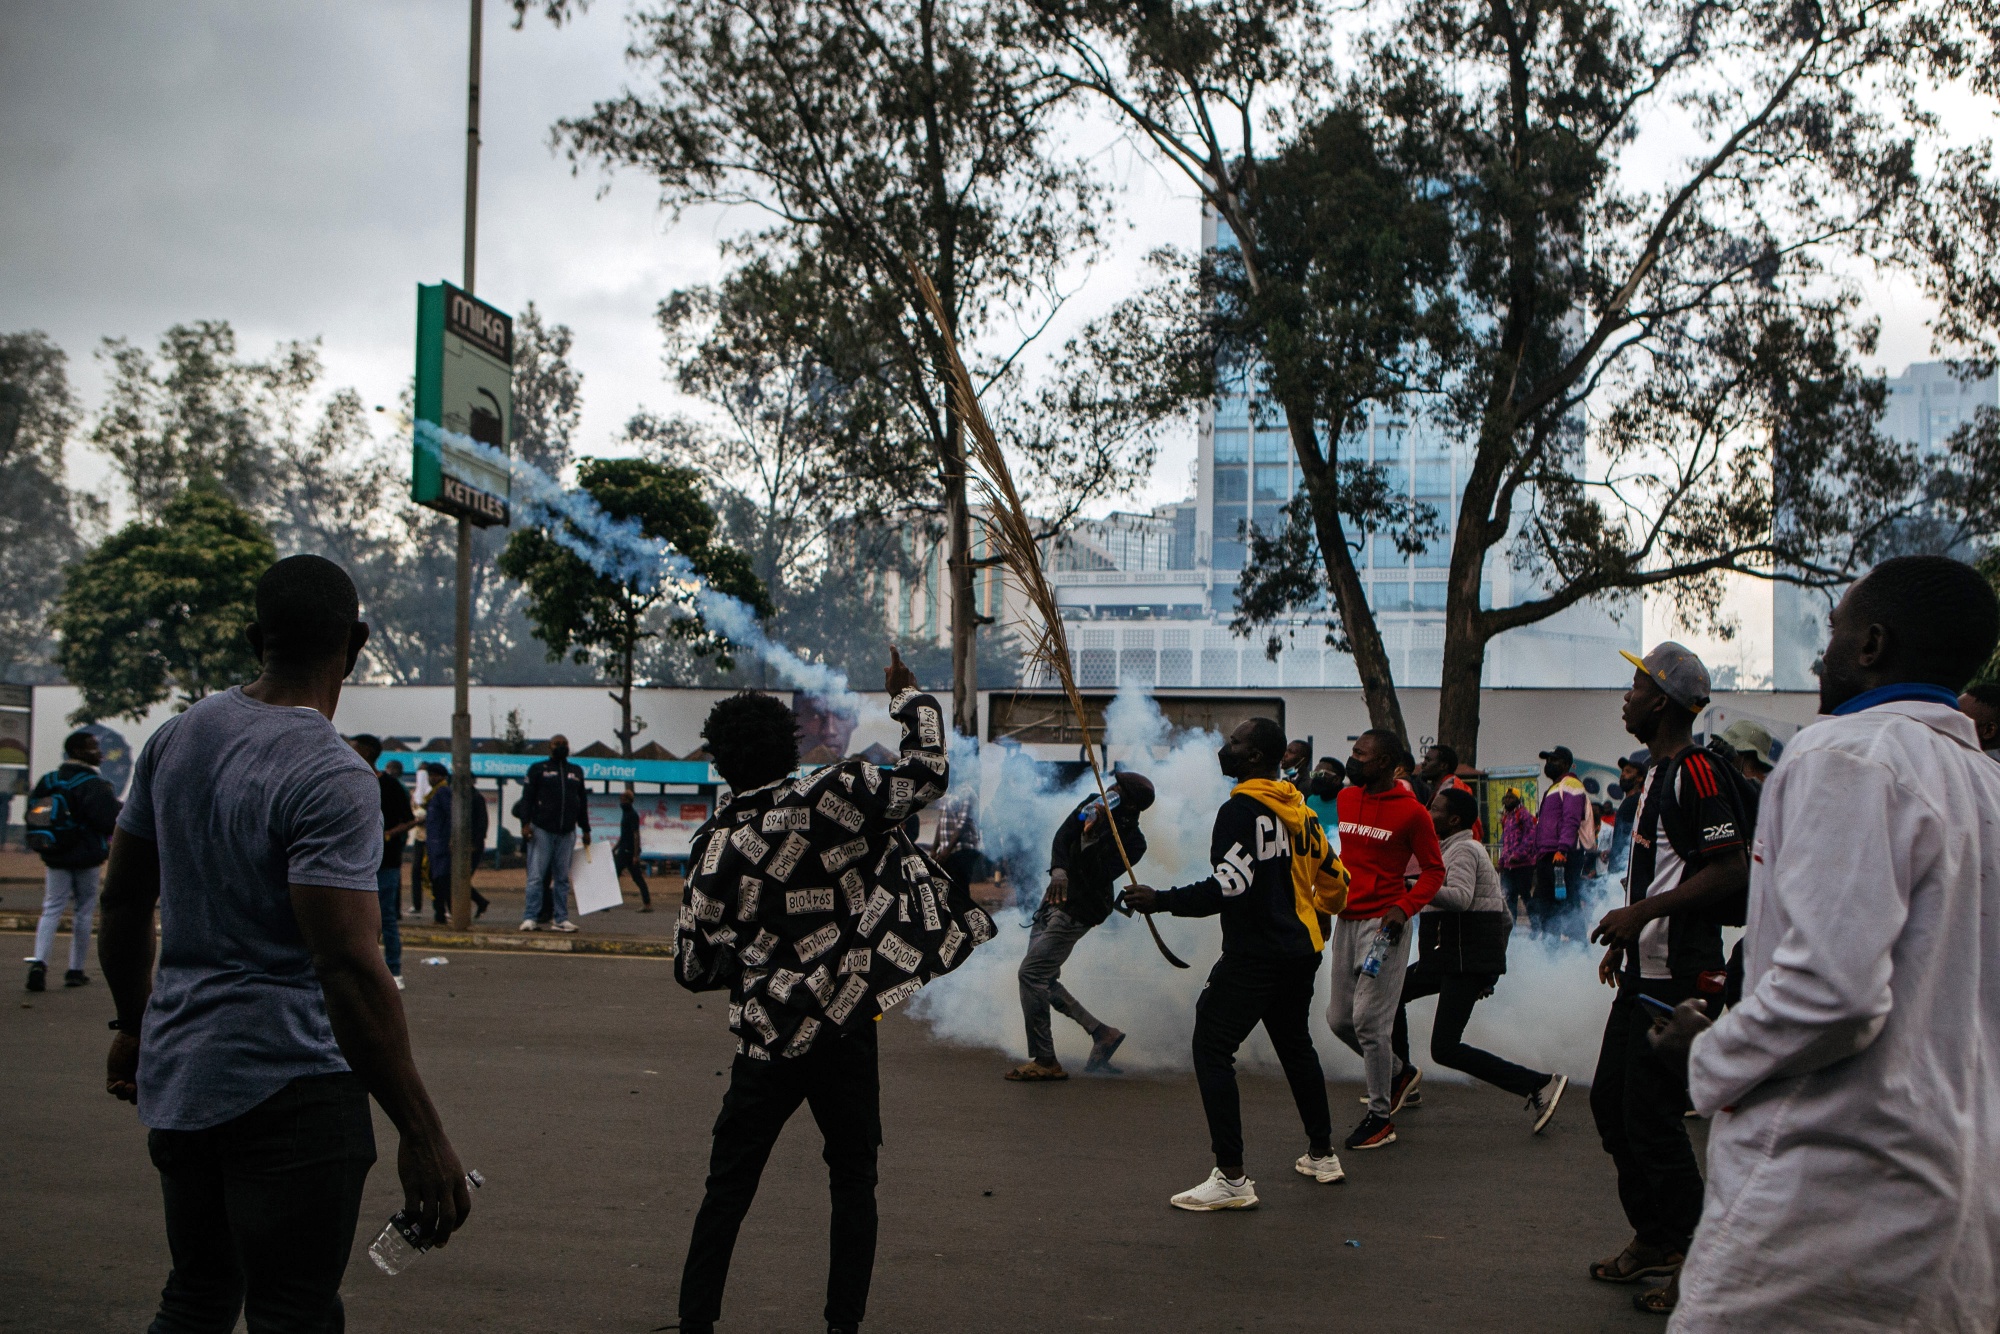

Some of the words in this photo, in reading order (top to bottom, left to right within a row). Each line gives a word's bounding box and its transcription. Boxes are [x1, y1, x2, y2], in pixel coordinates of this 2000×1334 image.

[444, 477, 504, 519] KETTLES
[924, 729, 936, 744] 018
[592, 763, 637, 778] Partner
[896, 781, 909, 798] 018
[766, 814, 783, 827] S94
[790, 812, 807, 825] 018
[821, 797, 841, 815] S94
[844, 810, 861, 827] 018
[747, 840, 763, 858] 018
[774, 837, 804, 877] CHILLY
[844, 872, 857, 890] 018
[789, 895, 806, 909] 018
[813, 893, 831, 906] S94
[920, 886, 933, 903] 018
[704, 904, 720, 918] 018
[860, 892, 888, 933] CHILLY
[801, 928, 838, 955] CHILLY
[745, 949, 761, 965] 018
[853, 955, 868, 967] 018
[882, 938, 901, 956] S94
[901, 951, 918, 967] 018
[821, 984, 833, 1002] 018
[832, 980, 862, 1020] CHILLY
[746, 1003, 760, 1021] S94
